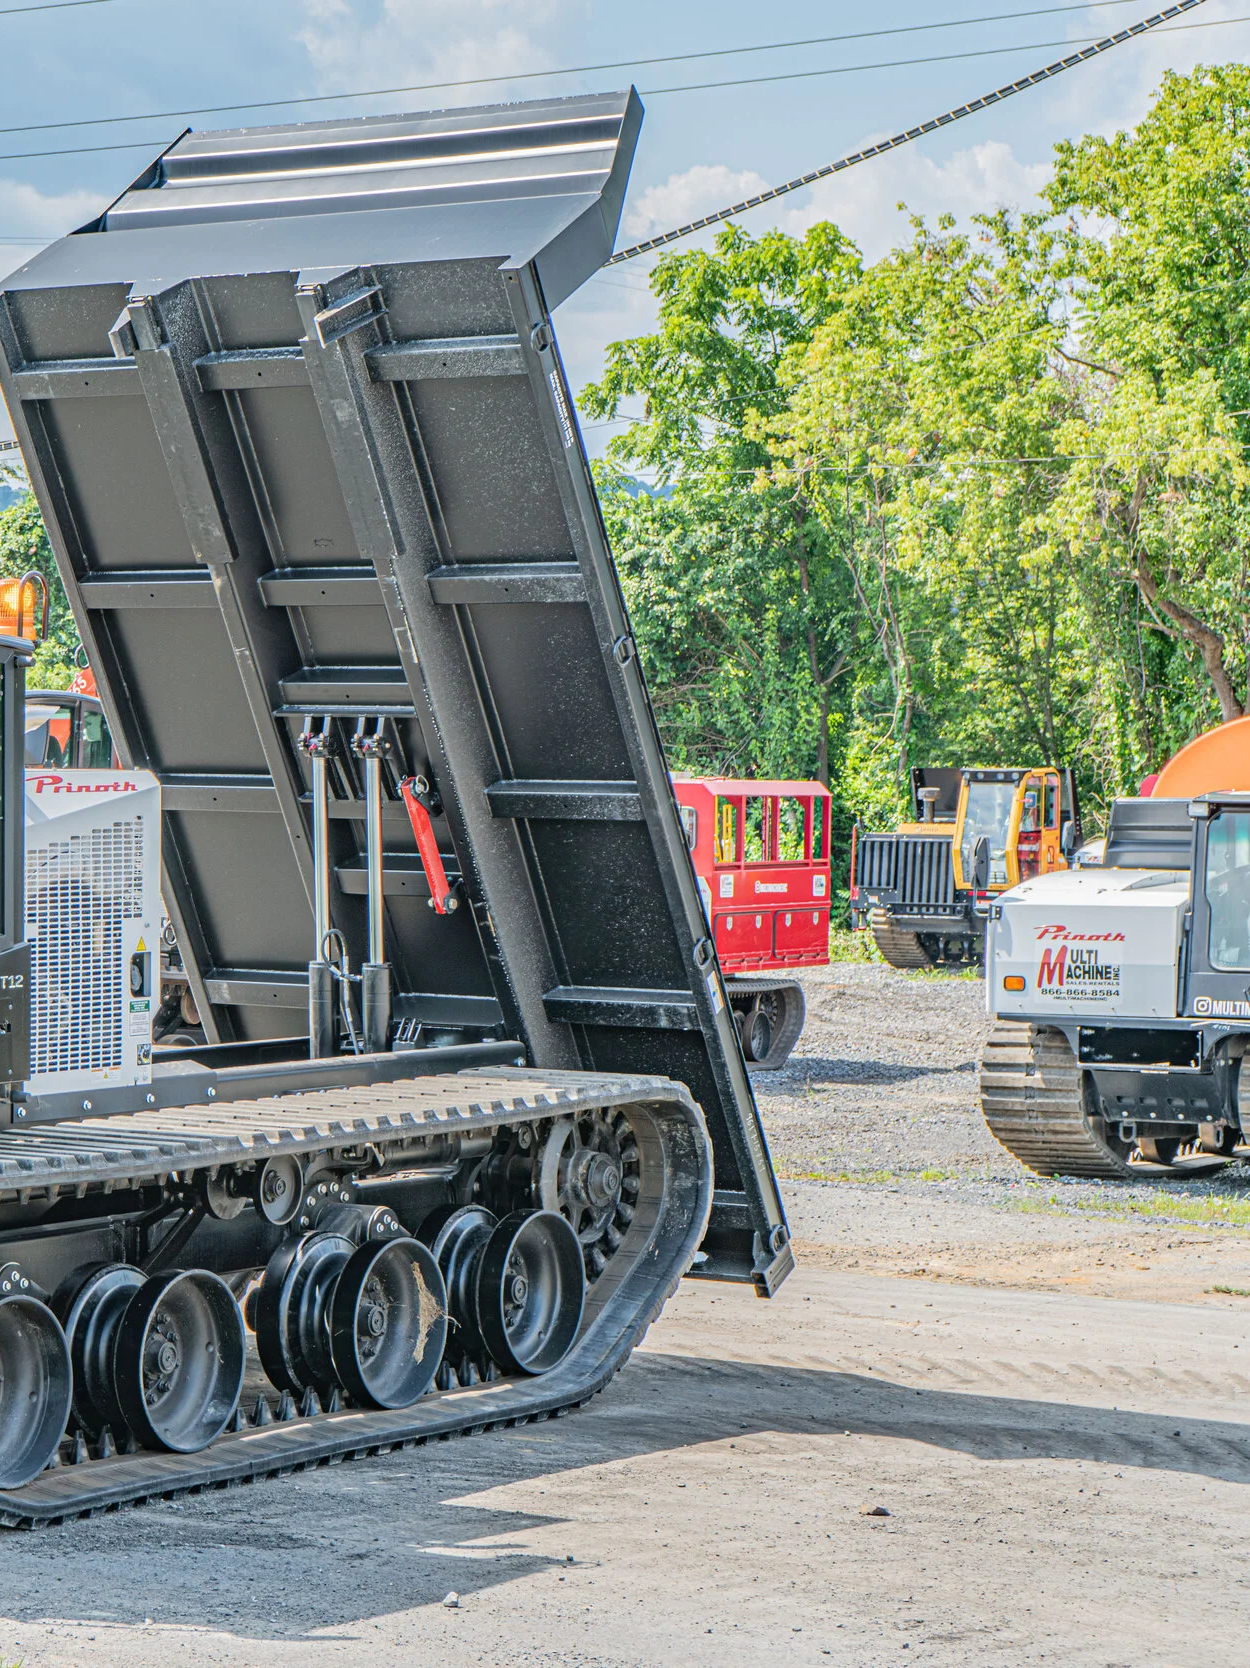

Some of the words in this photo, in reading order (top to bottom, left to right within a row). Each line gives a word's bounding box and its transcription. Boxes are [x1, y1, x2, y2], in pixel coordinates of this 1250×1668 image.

[25, 775, 138, 793] Prinoth
[1033, 924, 1125, 942] Prinoth
[0, 974, 24, 989] T12
[1041, 988, 1120, 997] 866-866-8584
